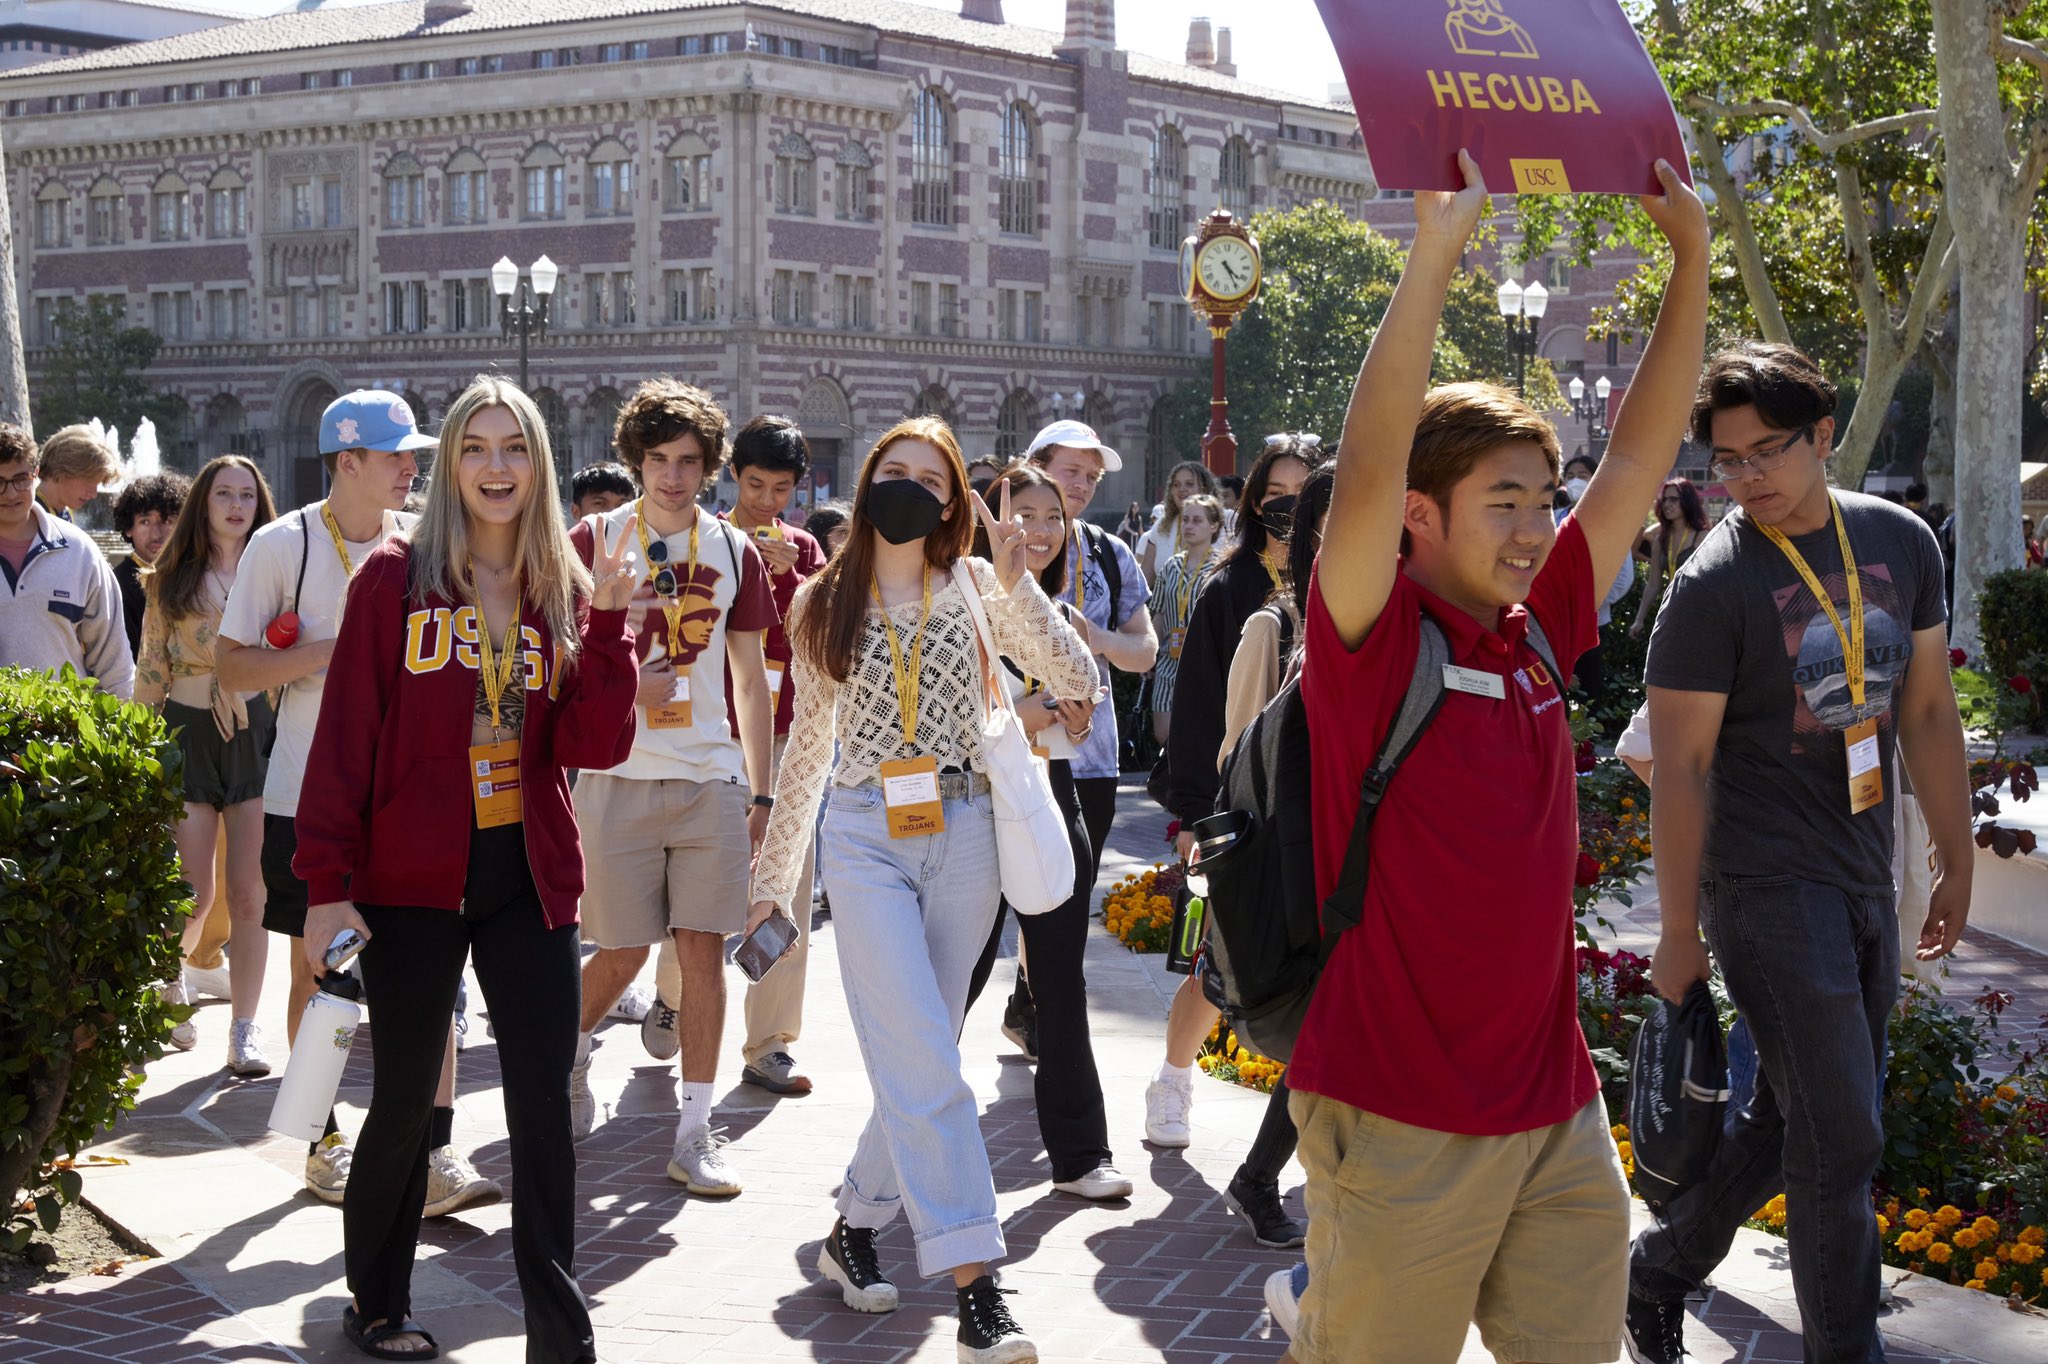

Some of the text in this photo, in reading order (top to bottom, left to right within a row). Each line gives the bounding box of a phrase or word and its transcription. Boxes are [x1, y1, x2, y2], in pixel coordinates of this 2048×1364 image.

[1426, 69, 1602, 114] HECUBA
[1524, 168, 1557, 186] USC
[898, 821, 936, 832] TROJANS
